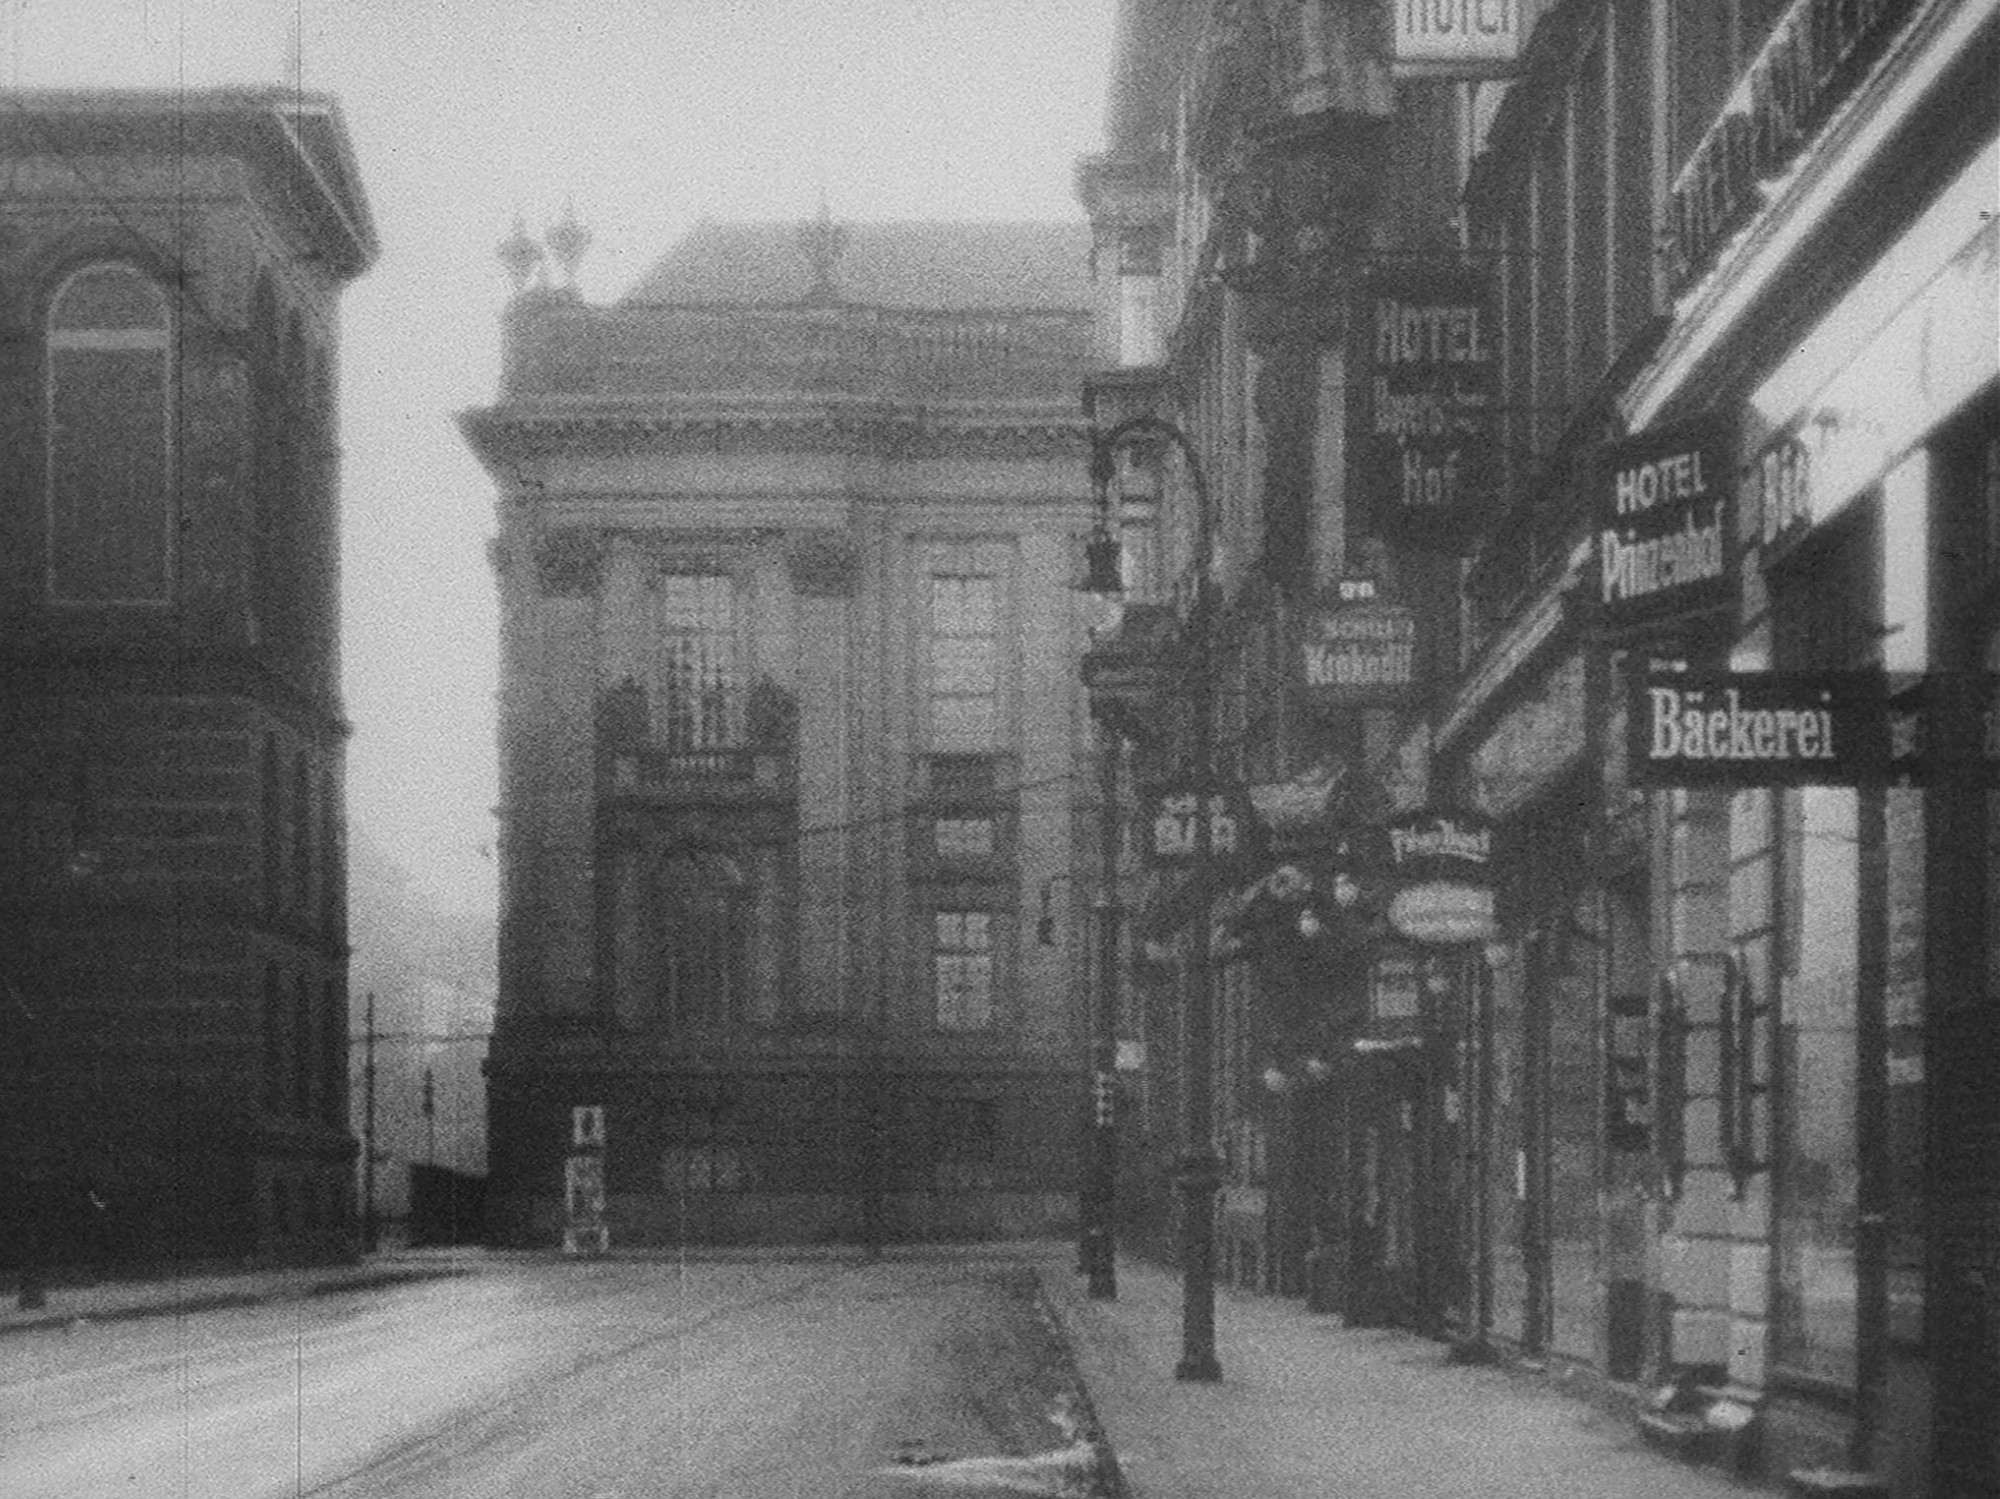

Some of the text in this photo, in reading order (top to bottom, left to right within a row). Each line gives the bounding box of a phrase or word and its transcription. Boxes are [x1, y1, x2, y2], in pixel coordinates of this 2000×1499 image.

[1374, 297, 1490, 364] HOTEL
[1616, 449, 1707, 516] HOTEL
[1647, 687, 1836, 760] Bäckerei
